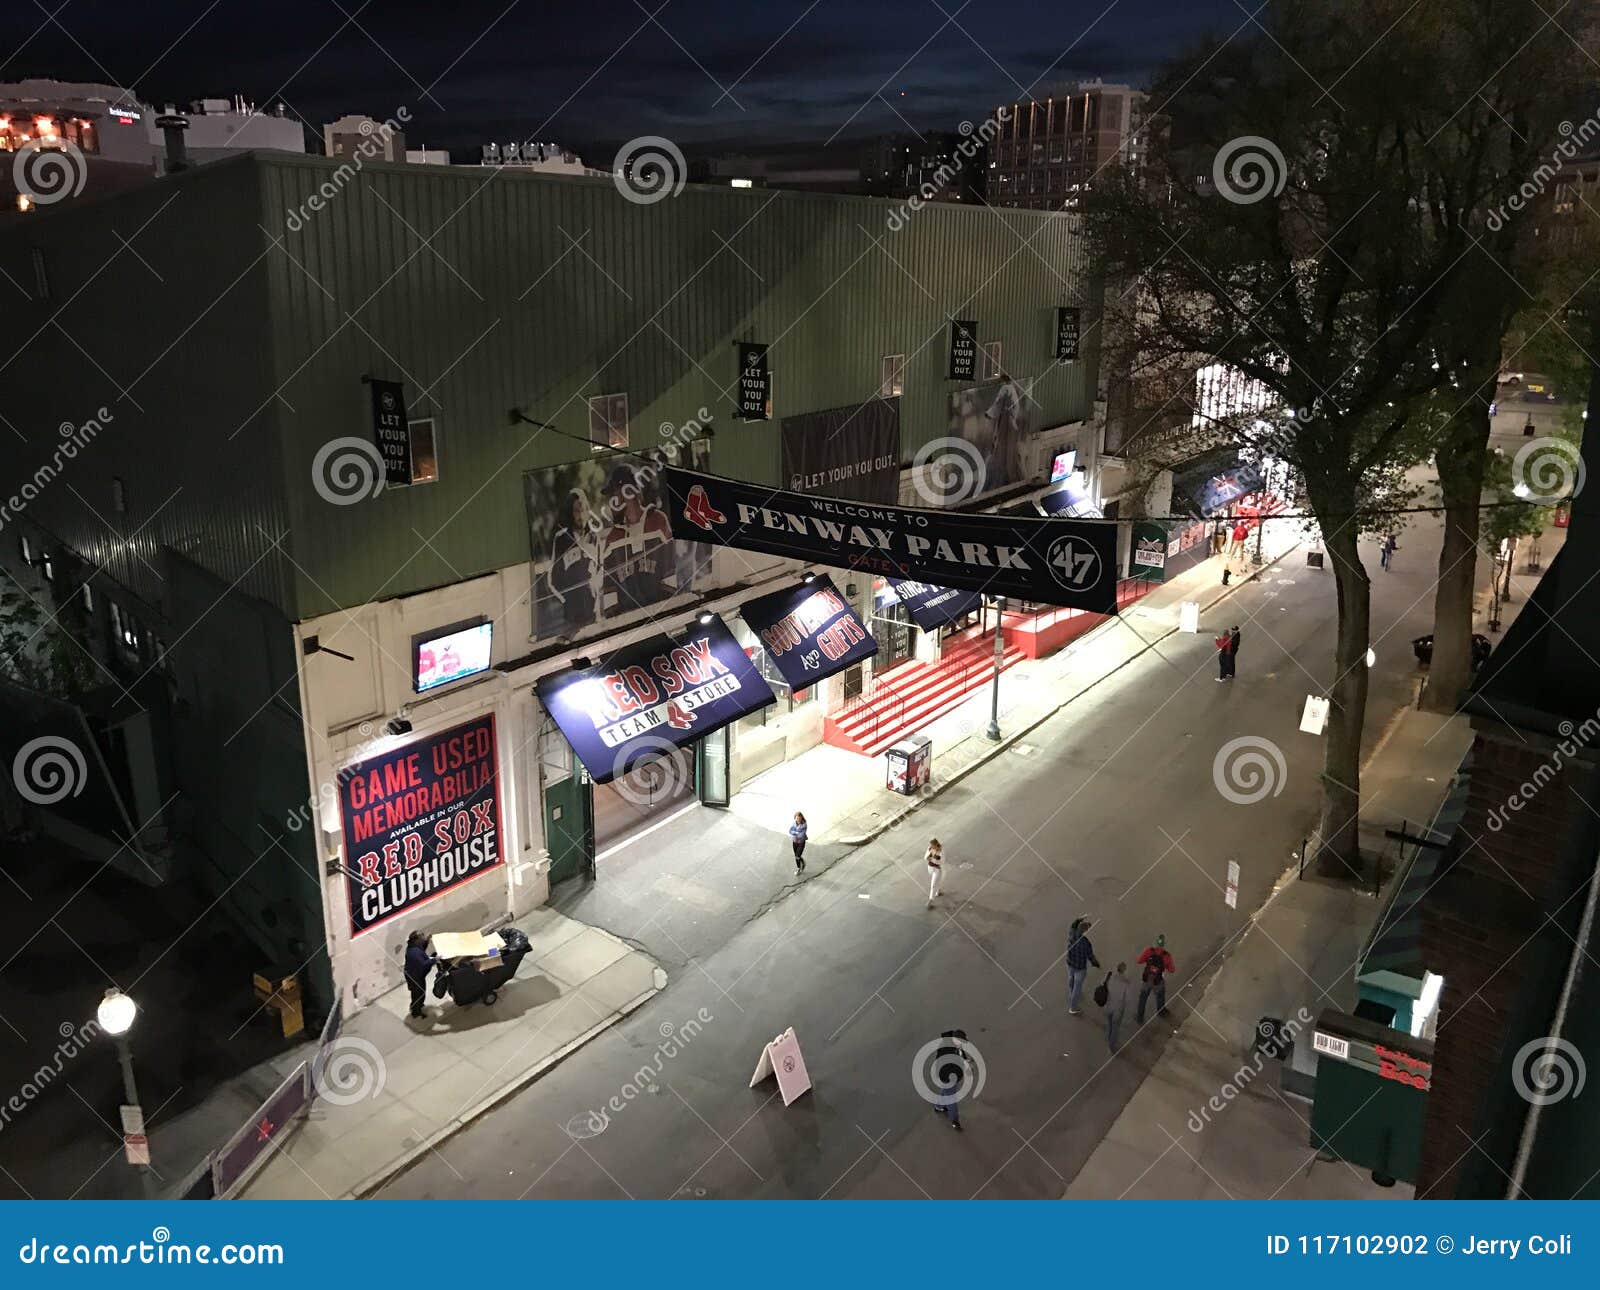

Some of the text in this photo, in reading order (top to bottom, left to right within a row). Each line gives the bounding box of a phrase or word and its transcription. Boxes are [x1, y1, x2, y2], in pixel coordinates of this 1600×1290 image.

[742, 379, 765, 389] YOUR
[745, 368, 761, 377] LET
[744, 390, 762, 400] YOU
[378, 428, 407, 441] YOUR
[380, 414, 400, 426] LET
[383, 444, 404, 456] YOU
[805, 472, 825, 489] LET
[827, 464, 853, 483] YOUR
[855, 459, 874, 476] YOU
[810, 500, 929, 527] WELCOME TO
[736, 503, 1033, 570] FENWAY PARK
[761, 588, 845, 656] SOUVERS
[816, 613, 866, 661] GIFTS
[651, 637, 731, 698] SOX
[606, 677, 736, 742] TEAM STORE
[350, 728, 489, 810] GAME USED
[353, 761, 491, 843] MEMORABILIA
[389, 801, 465, 839] AVAILABLE IN OUR
[357, 798, 495, 887] RED SOX
[361, 830, 497, 922] CLUBHOUSE
